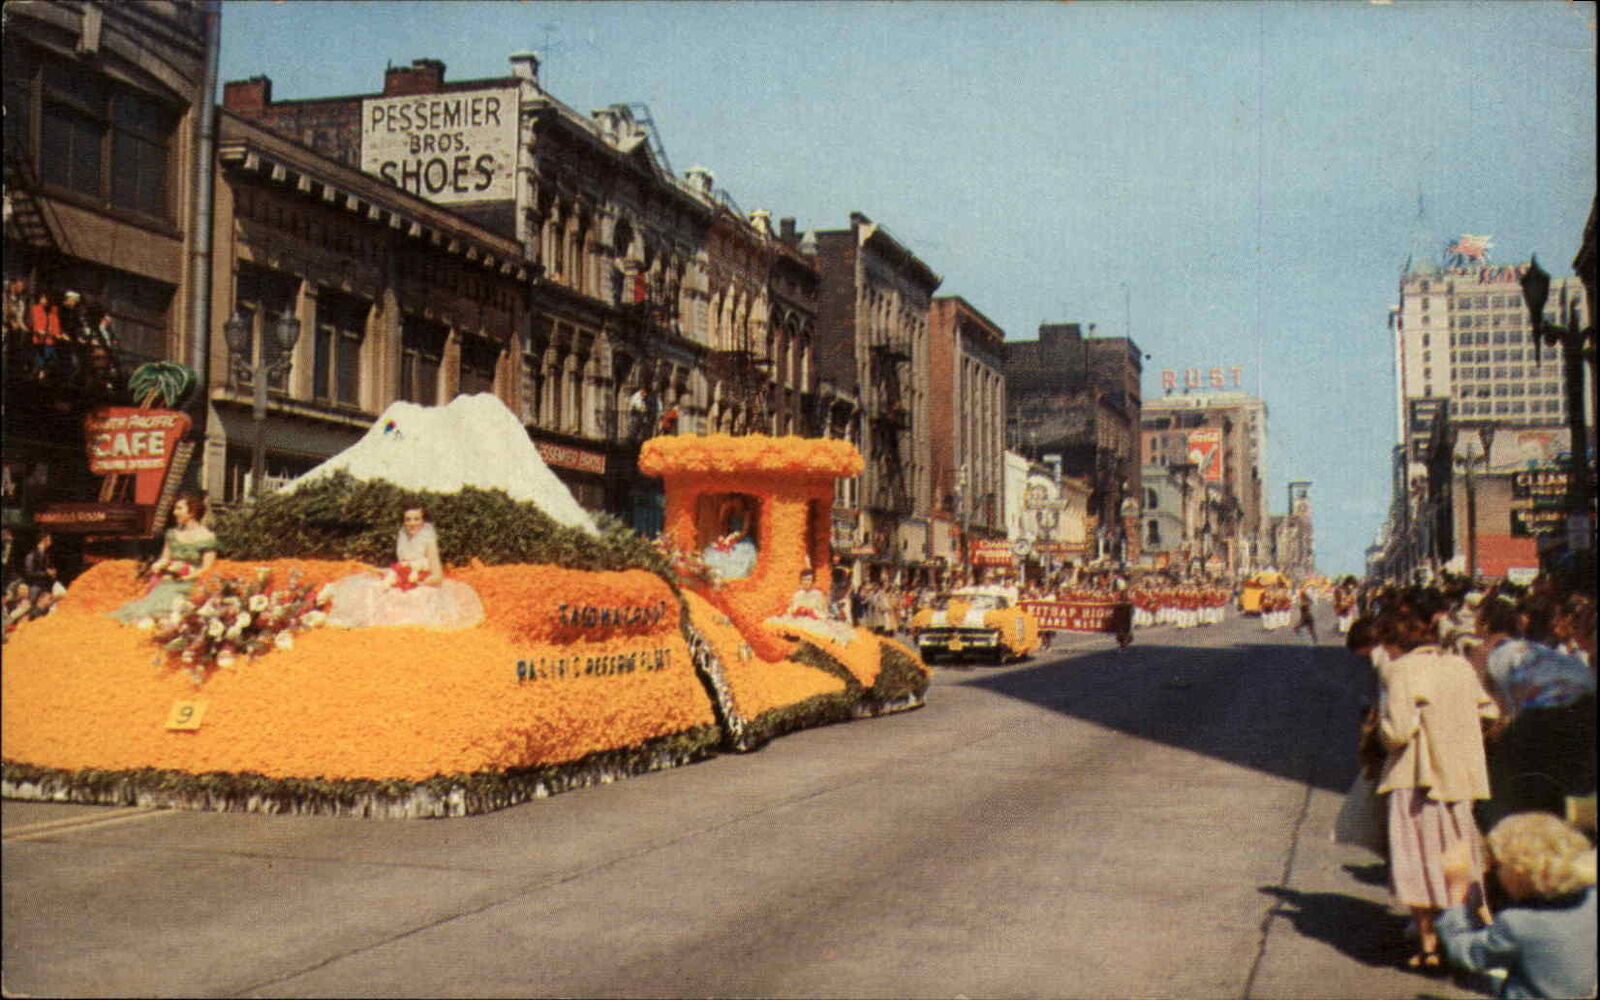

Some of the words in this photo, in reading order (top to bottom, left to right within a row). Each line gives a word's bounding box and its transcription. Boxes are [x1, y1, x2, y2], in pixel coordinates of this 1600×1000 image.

[371, 97, 501, 132] PESSEMIER
[409, 132, 470, 154] BROS.
[379, 154, 495, 195] SHOES
[1161, 366, 1243, 389] RUST
[92, 431, 166, 457] CAFE
[176, 705, 194, 724] 9
